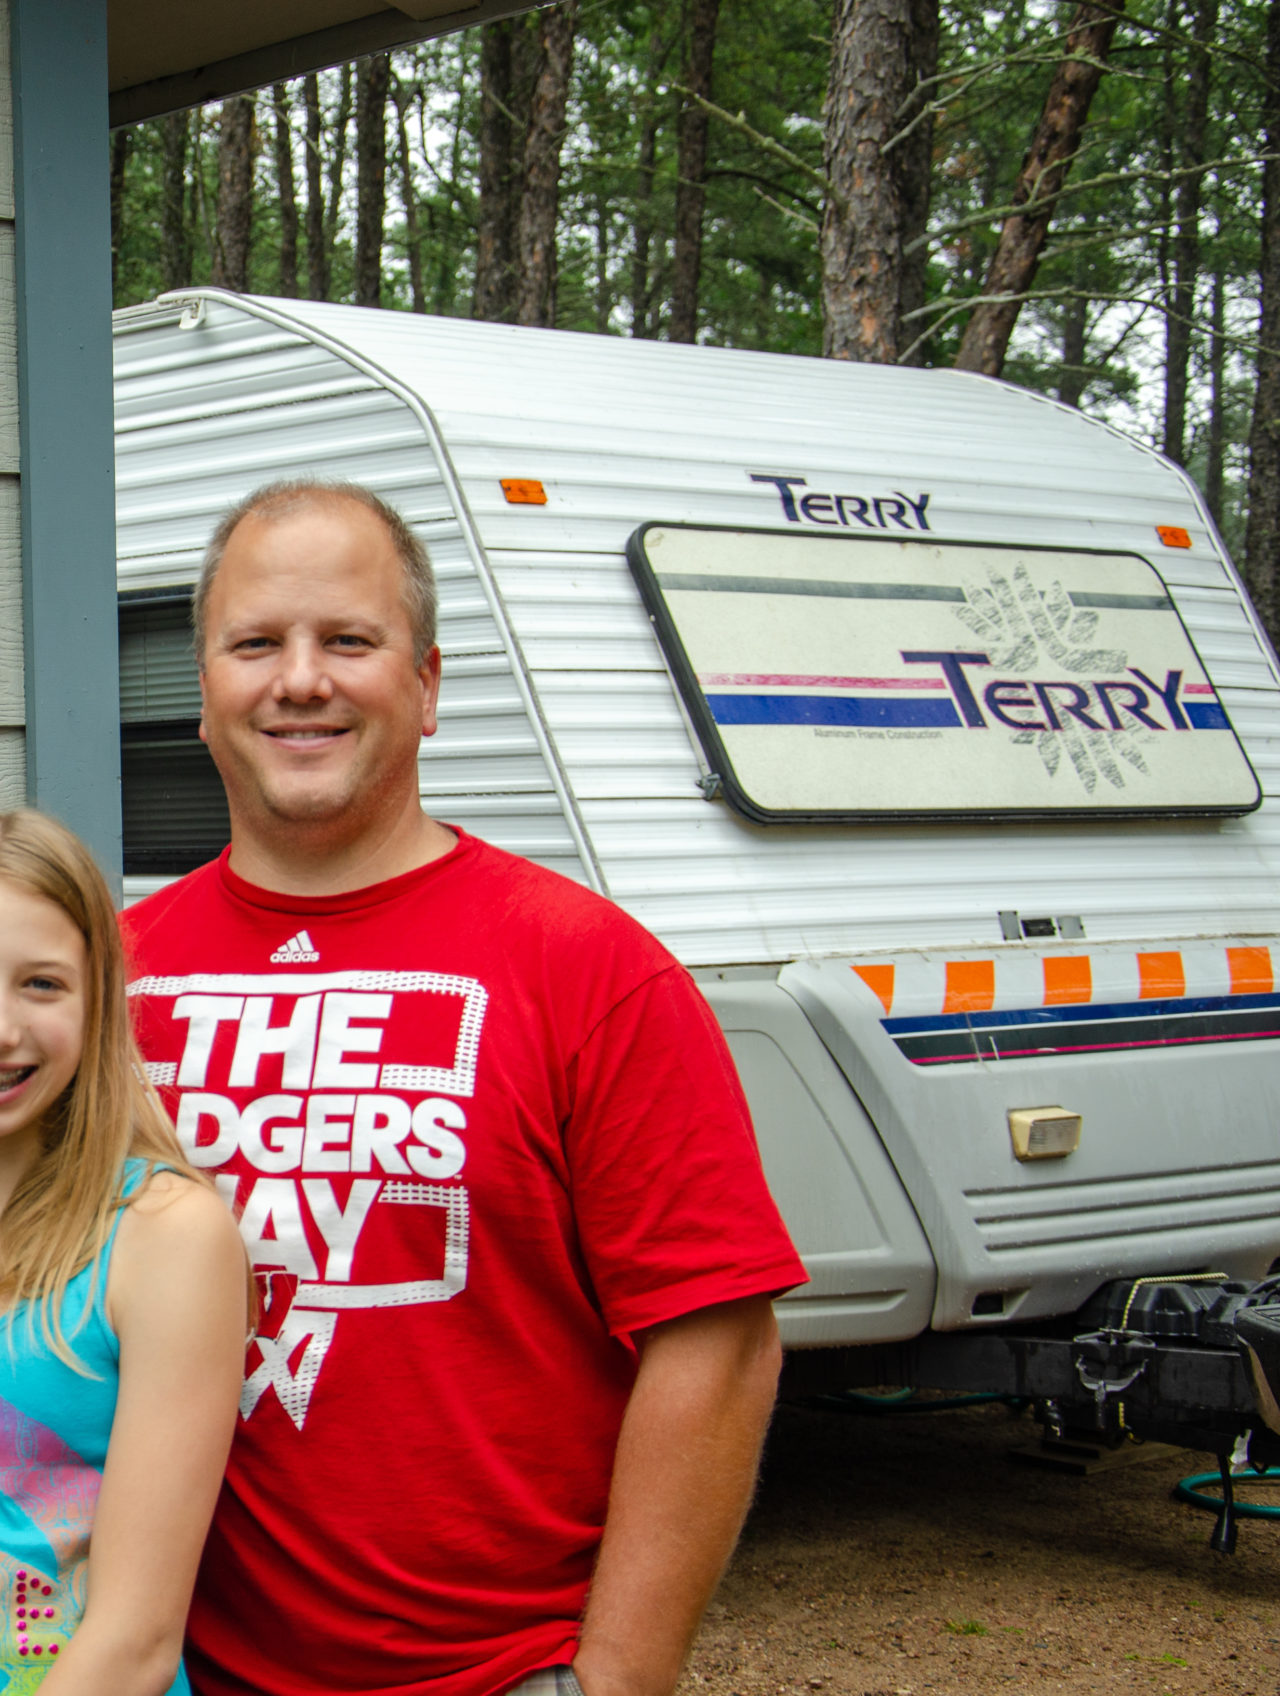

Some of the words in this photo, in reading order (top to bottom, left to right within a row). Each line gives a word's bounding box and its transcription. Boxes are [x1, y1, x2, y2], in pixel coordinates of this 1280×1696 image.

[813, 728, 858, 739] Aluminum
[858, 729, 886, 741] Frame
[887, 729, 944, 741] Construction
[270, 950, 320, 965] adidas
[171, 991, 394, 1090] THE
[214, 1172, 384, 1283] AY
